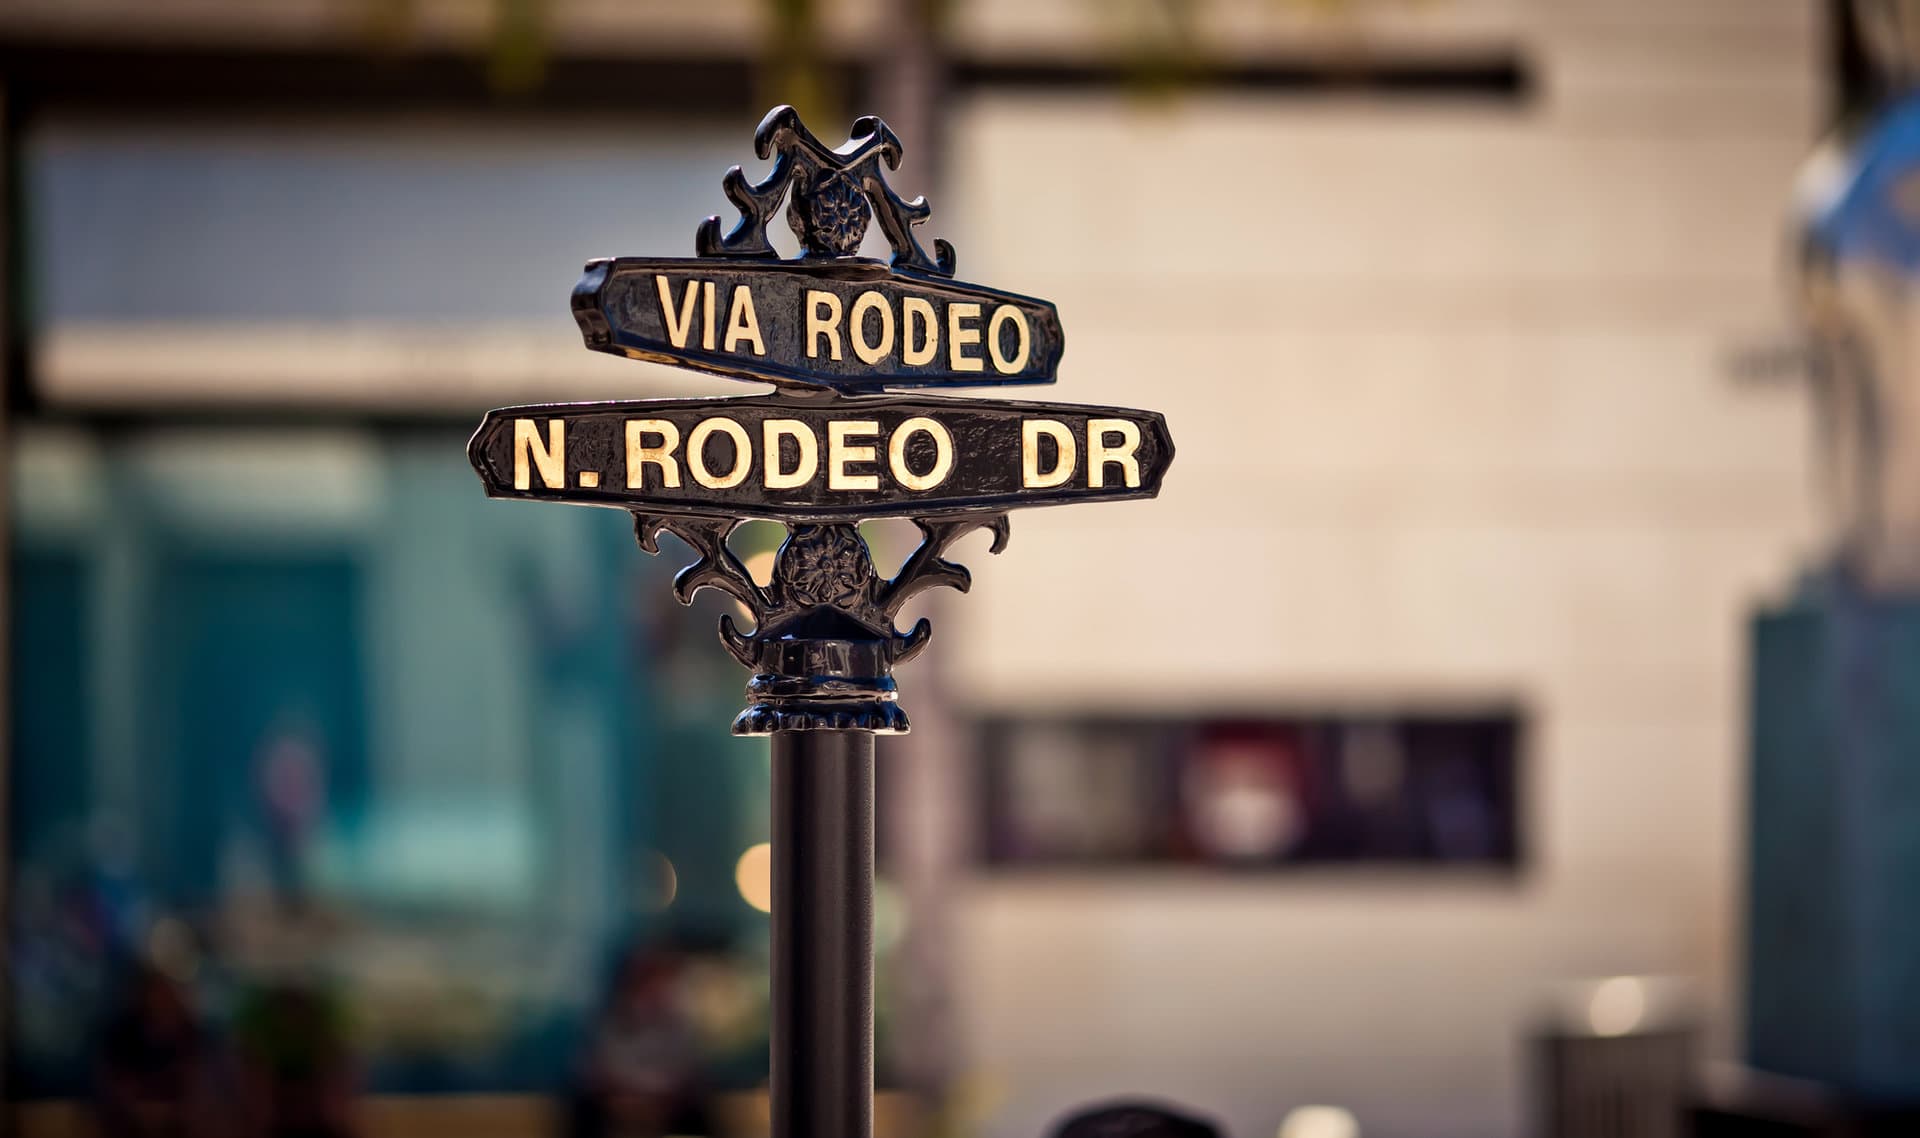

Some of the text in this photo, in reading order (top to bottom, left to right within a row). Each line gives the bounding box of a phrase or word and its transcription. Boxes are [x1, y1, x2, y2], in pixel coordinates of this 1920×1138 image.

[656, 275, 1031, 375] VIA RODEO
[514, 416, 1141, 491] N. RODEO DR
